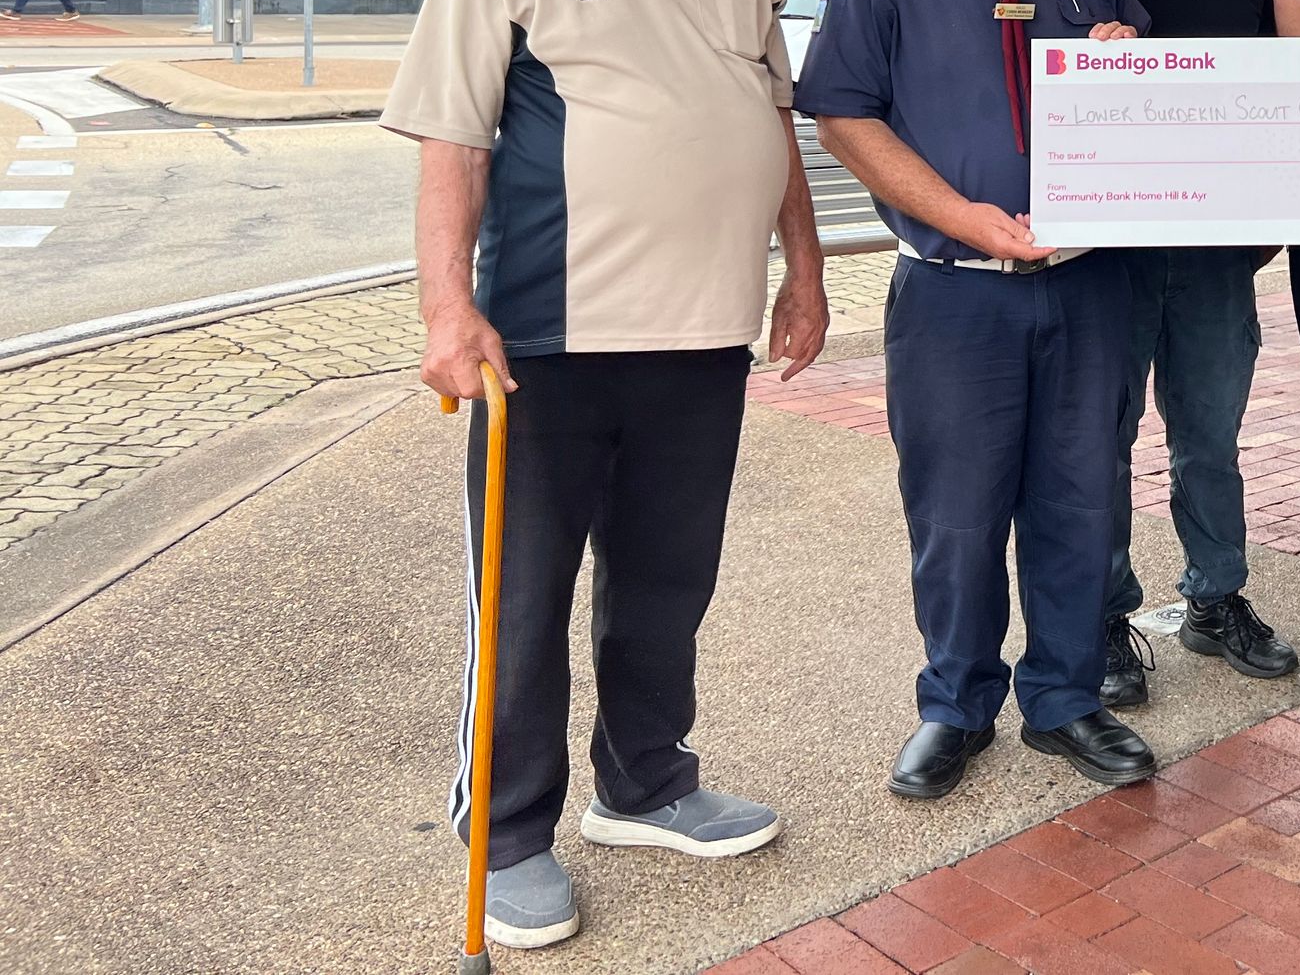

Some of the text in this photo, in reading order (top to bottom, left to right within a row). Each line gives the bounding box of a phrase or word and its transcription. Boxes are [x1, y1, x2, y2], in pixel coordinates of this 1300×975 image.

[1076, 53, 1159, 75] Bendigo
[1165, 52, 1217, 70] Bank
[1047, 112, 1066, 123] Pay
[1073, 103, 1134, 125] LOWER
[1143, 98, 1227, 123] BURDEKIN
[1047, 151, 1065, 161] The
[1086, 151, 1097, 160] of
[1047, 183, 1067, 192] From
[1047, 191, 1208, 204] Community Bank Home Hill & Ayr
